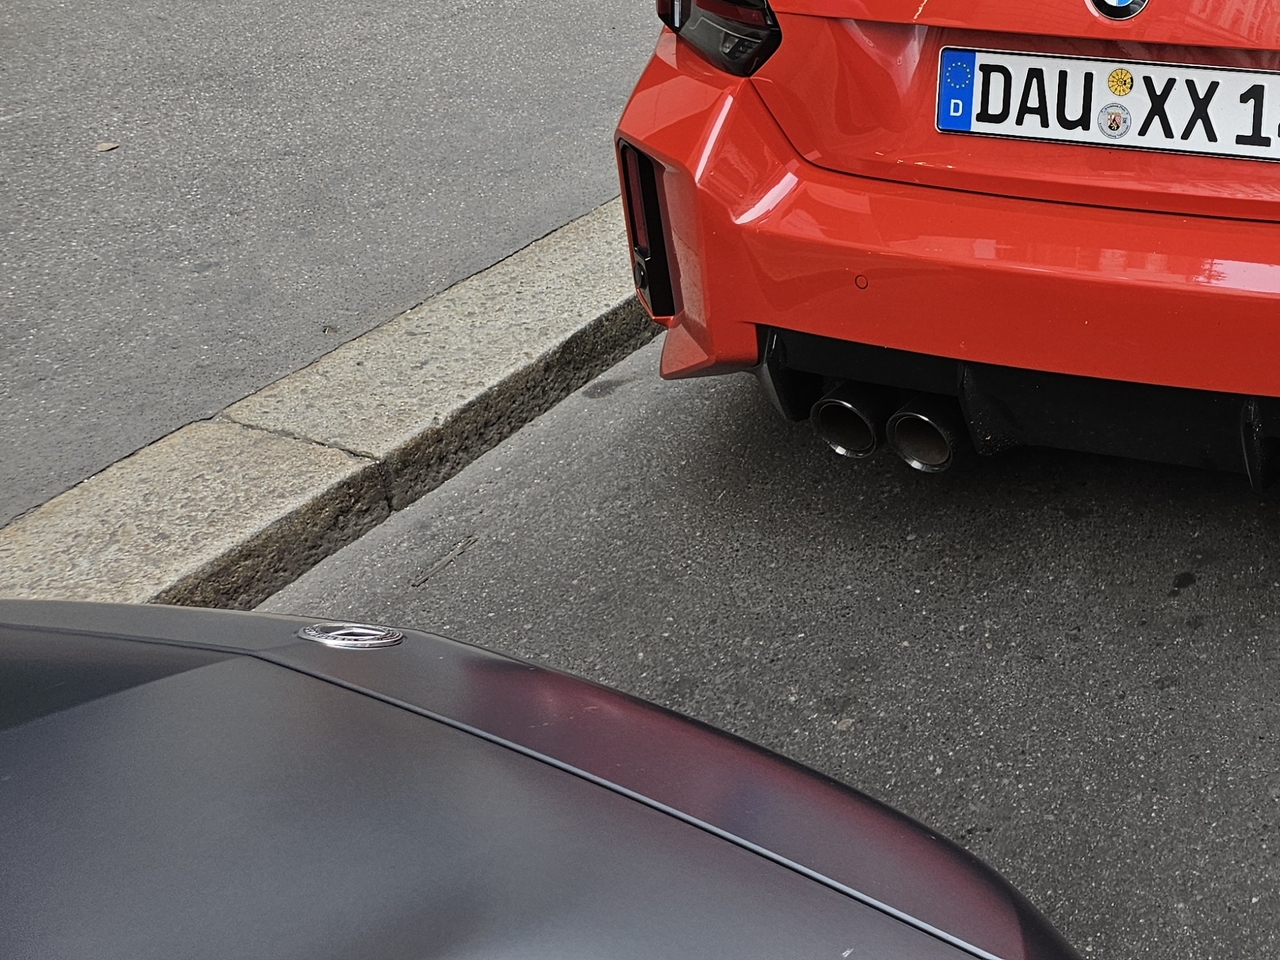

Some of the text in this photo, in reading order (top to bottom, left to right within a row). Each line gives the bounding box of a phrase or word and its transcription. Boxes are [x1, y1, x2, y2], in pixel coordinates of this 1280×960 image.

[950, 99, 963, 116] D
[976, 63, 1094, 131] DAU
[1138, 76, 1220, 142] XX
